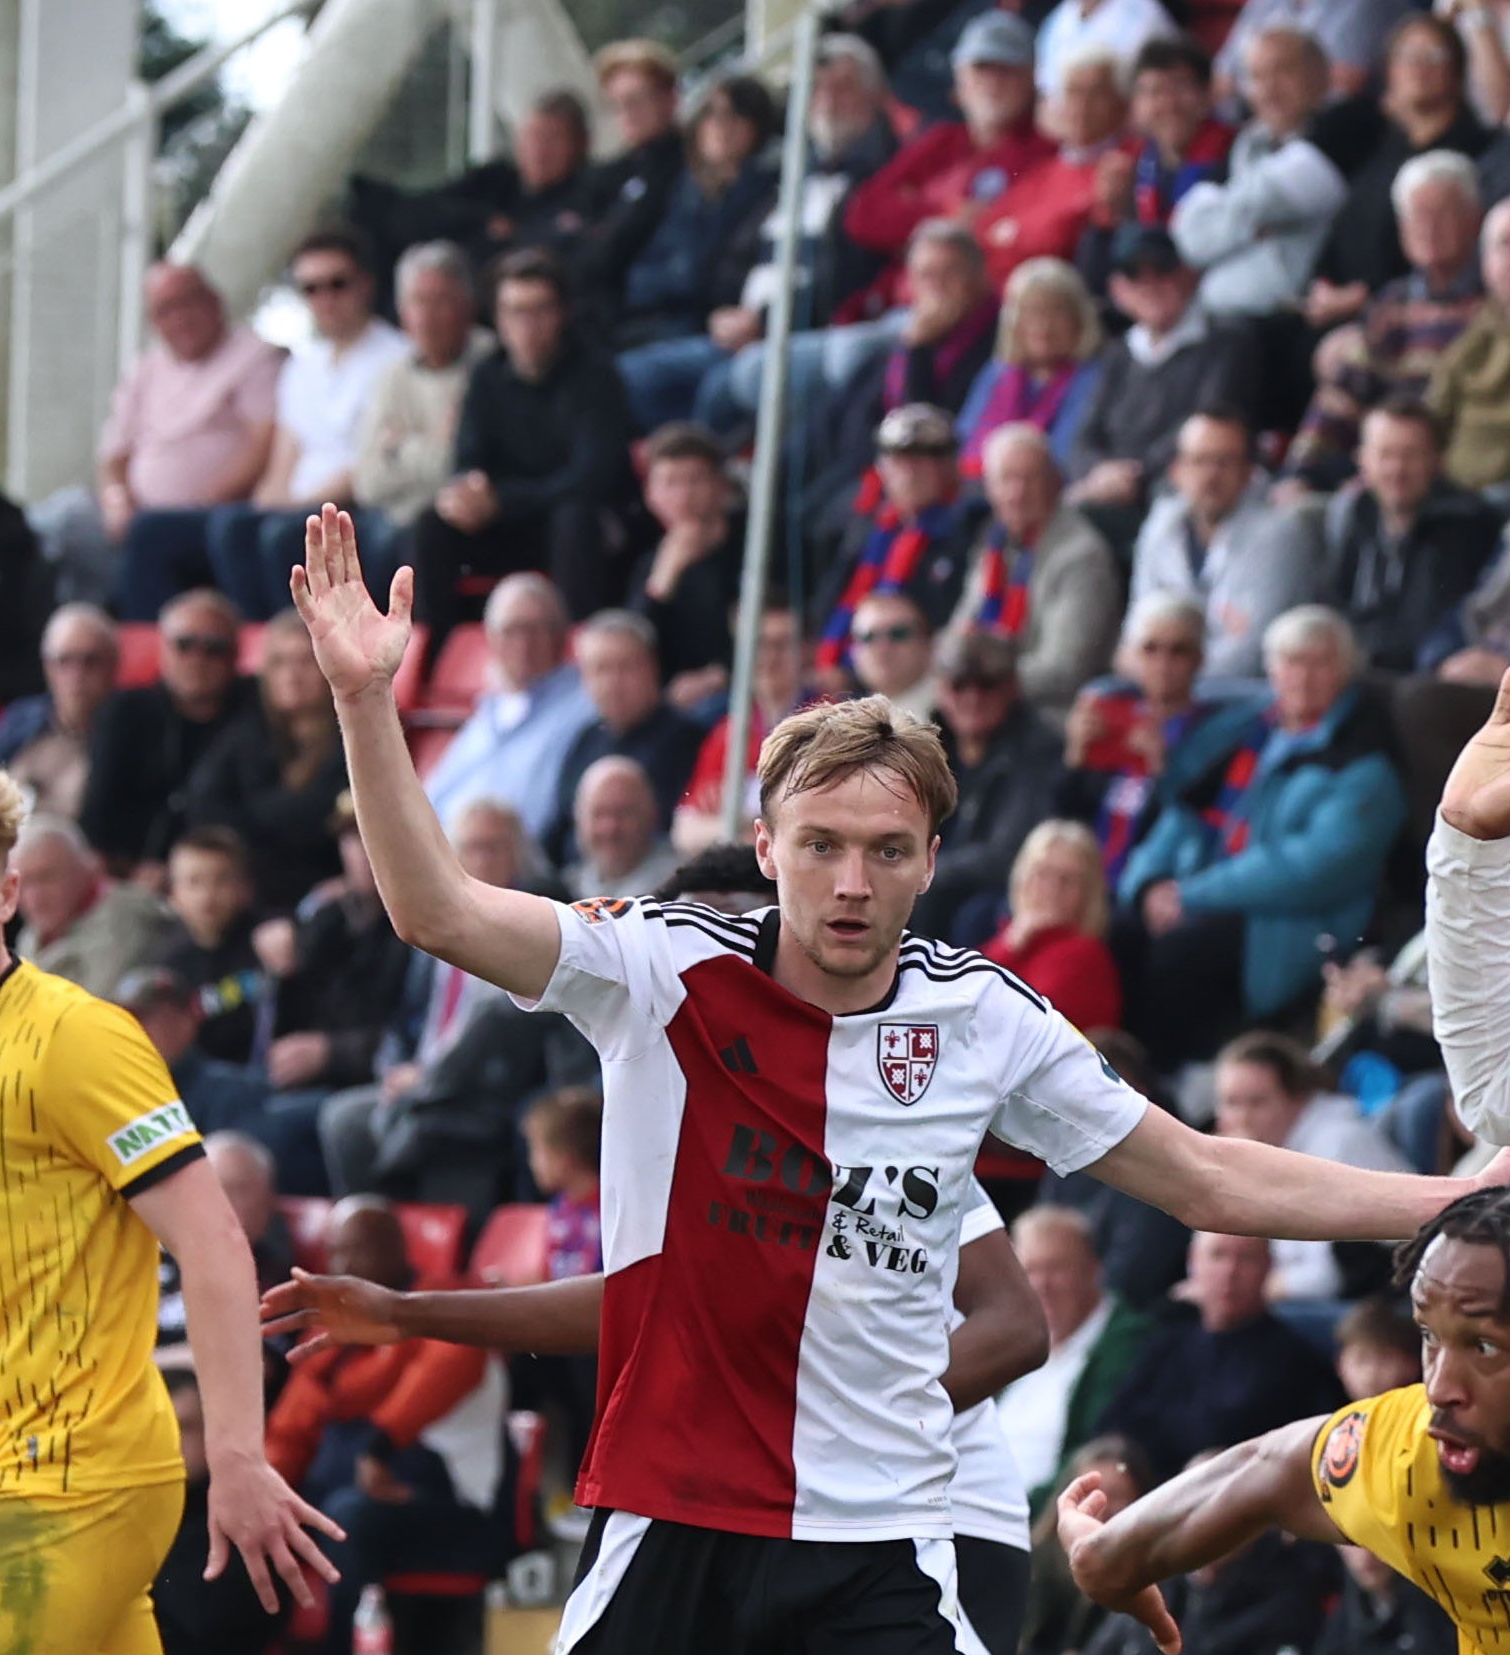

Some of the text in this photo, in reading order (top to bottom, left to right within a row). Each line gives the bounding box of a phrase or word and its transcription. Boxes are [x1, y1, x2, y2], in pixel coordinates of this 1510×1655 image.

[113, 1107, 191, 1158] NATT
[719, 1122, 939, 1219] BOZ'S
[707, 1200, 929, 1274] FRUIT & VEG
[832, 1211, 848, 1232] &
[855, 1216, 905, 1242] Retail
